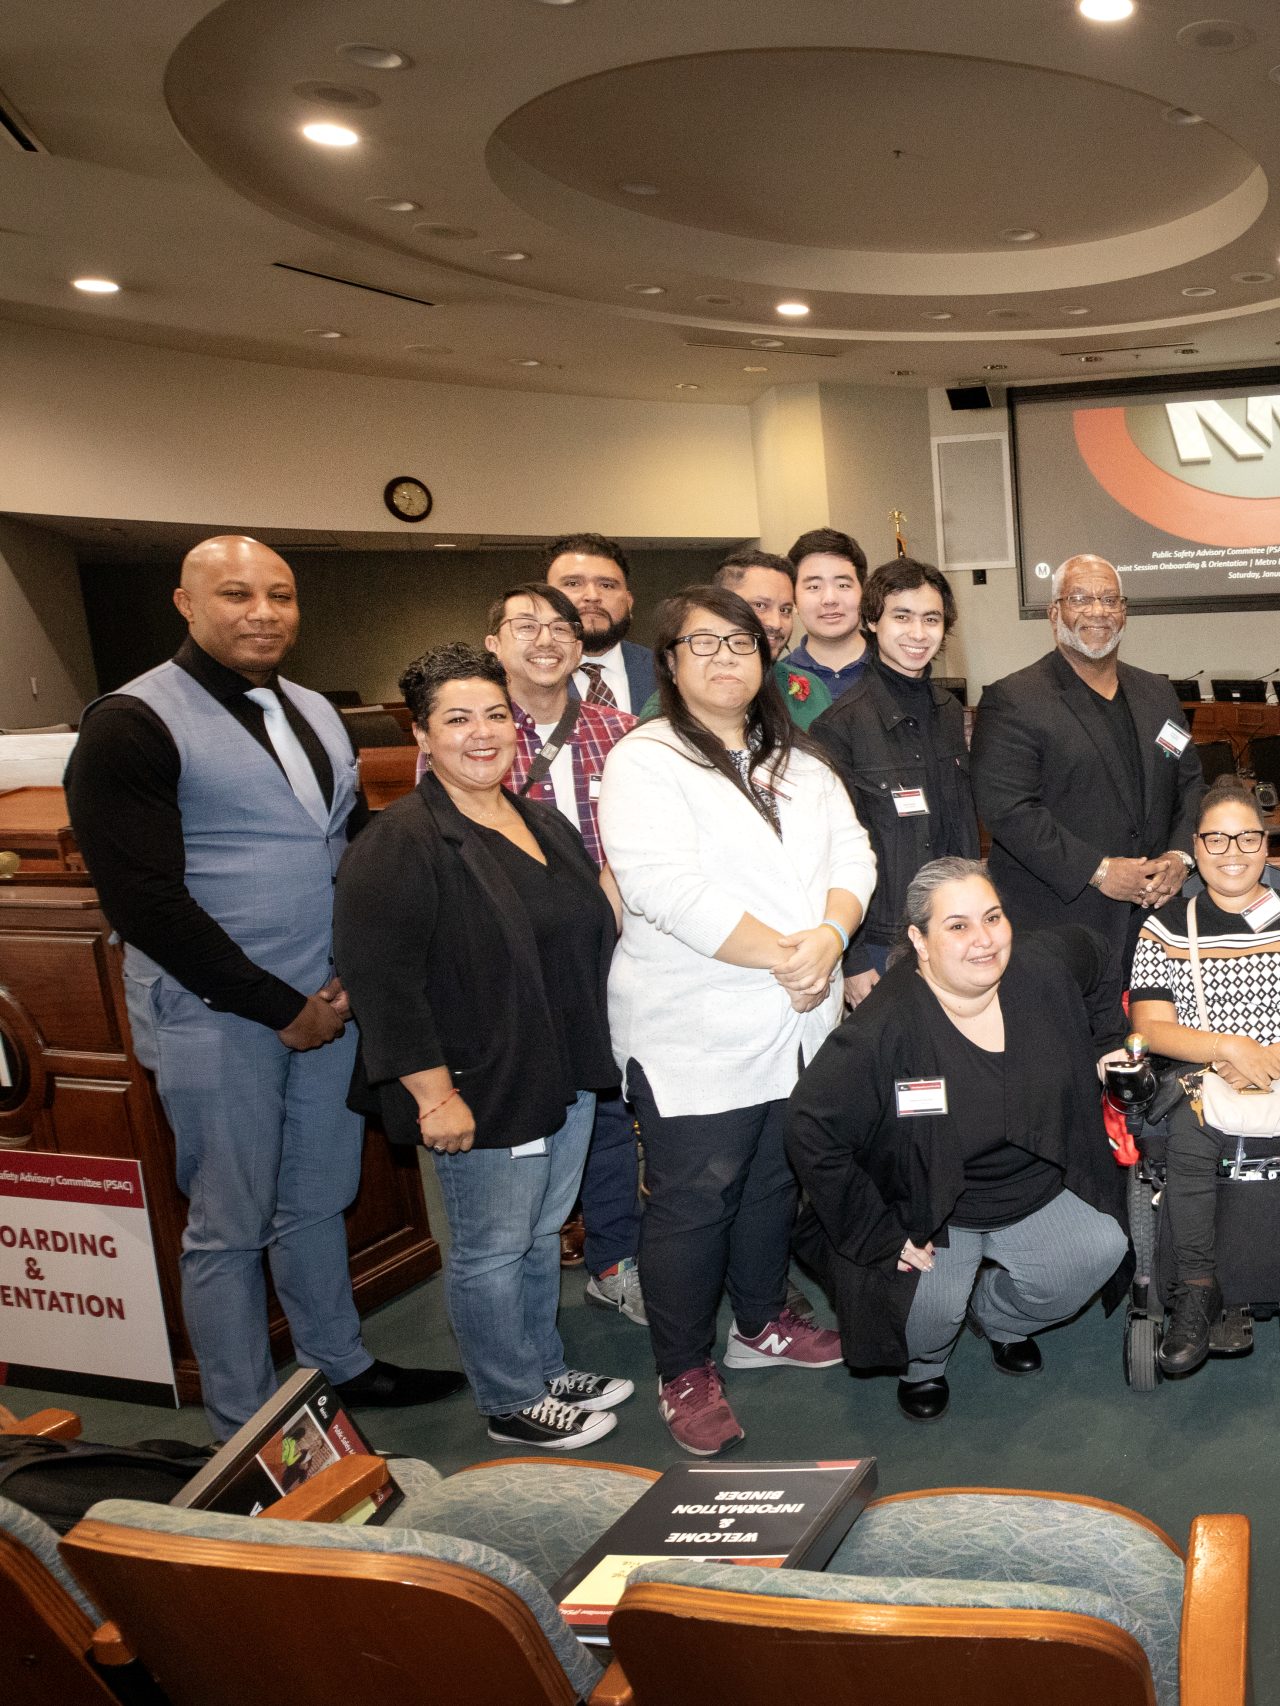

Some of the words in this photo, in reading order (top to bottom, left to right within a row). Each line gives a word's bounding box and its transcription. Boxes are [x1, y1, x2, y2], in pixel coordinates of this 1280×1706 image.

[1152, 551, 1173, 559] Public
[1174, 550, 1195, 559] Safety
[1195, 549, 1226, 558] Advisory
[1227, 547, 1265, 555] Committee
[1133, 563, 1158, 571] Session
[1159, 561, 1200, 570] Onboarding
[1201, 560, 1207, 568] &
[1208, 559, 1248, 568] Orientation
[1254, 558, 1277, 566] Metro
[1228, 570, 1261, 579] Saturday,
[20, 1172, 55, 1187] Advisory
[56, 1175, 102, 1189] Committee
[103, 1179, 134, 1194] (PSAC)
[0, 1225, 118, 1259] OARDING
[25, 1257, 45, 1280] &
[0, 1285, 126, 1320] ENTATION
[714, 1490, 786, 1501] BINDER
[671, 1503, 806, 1514] INFORMATION
[718, 1518, 736, 1529] &
[664, 1532, 759, 1543] WELCOME
